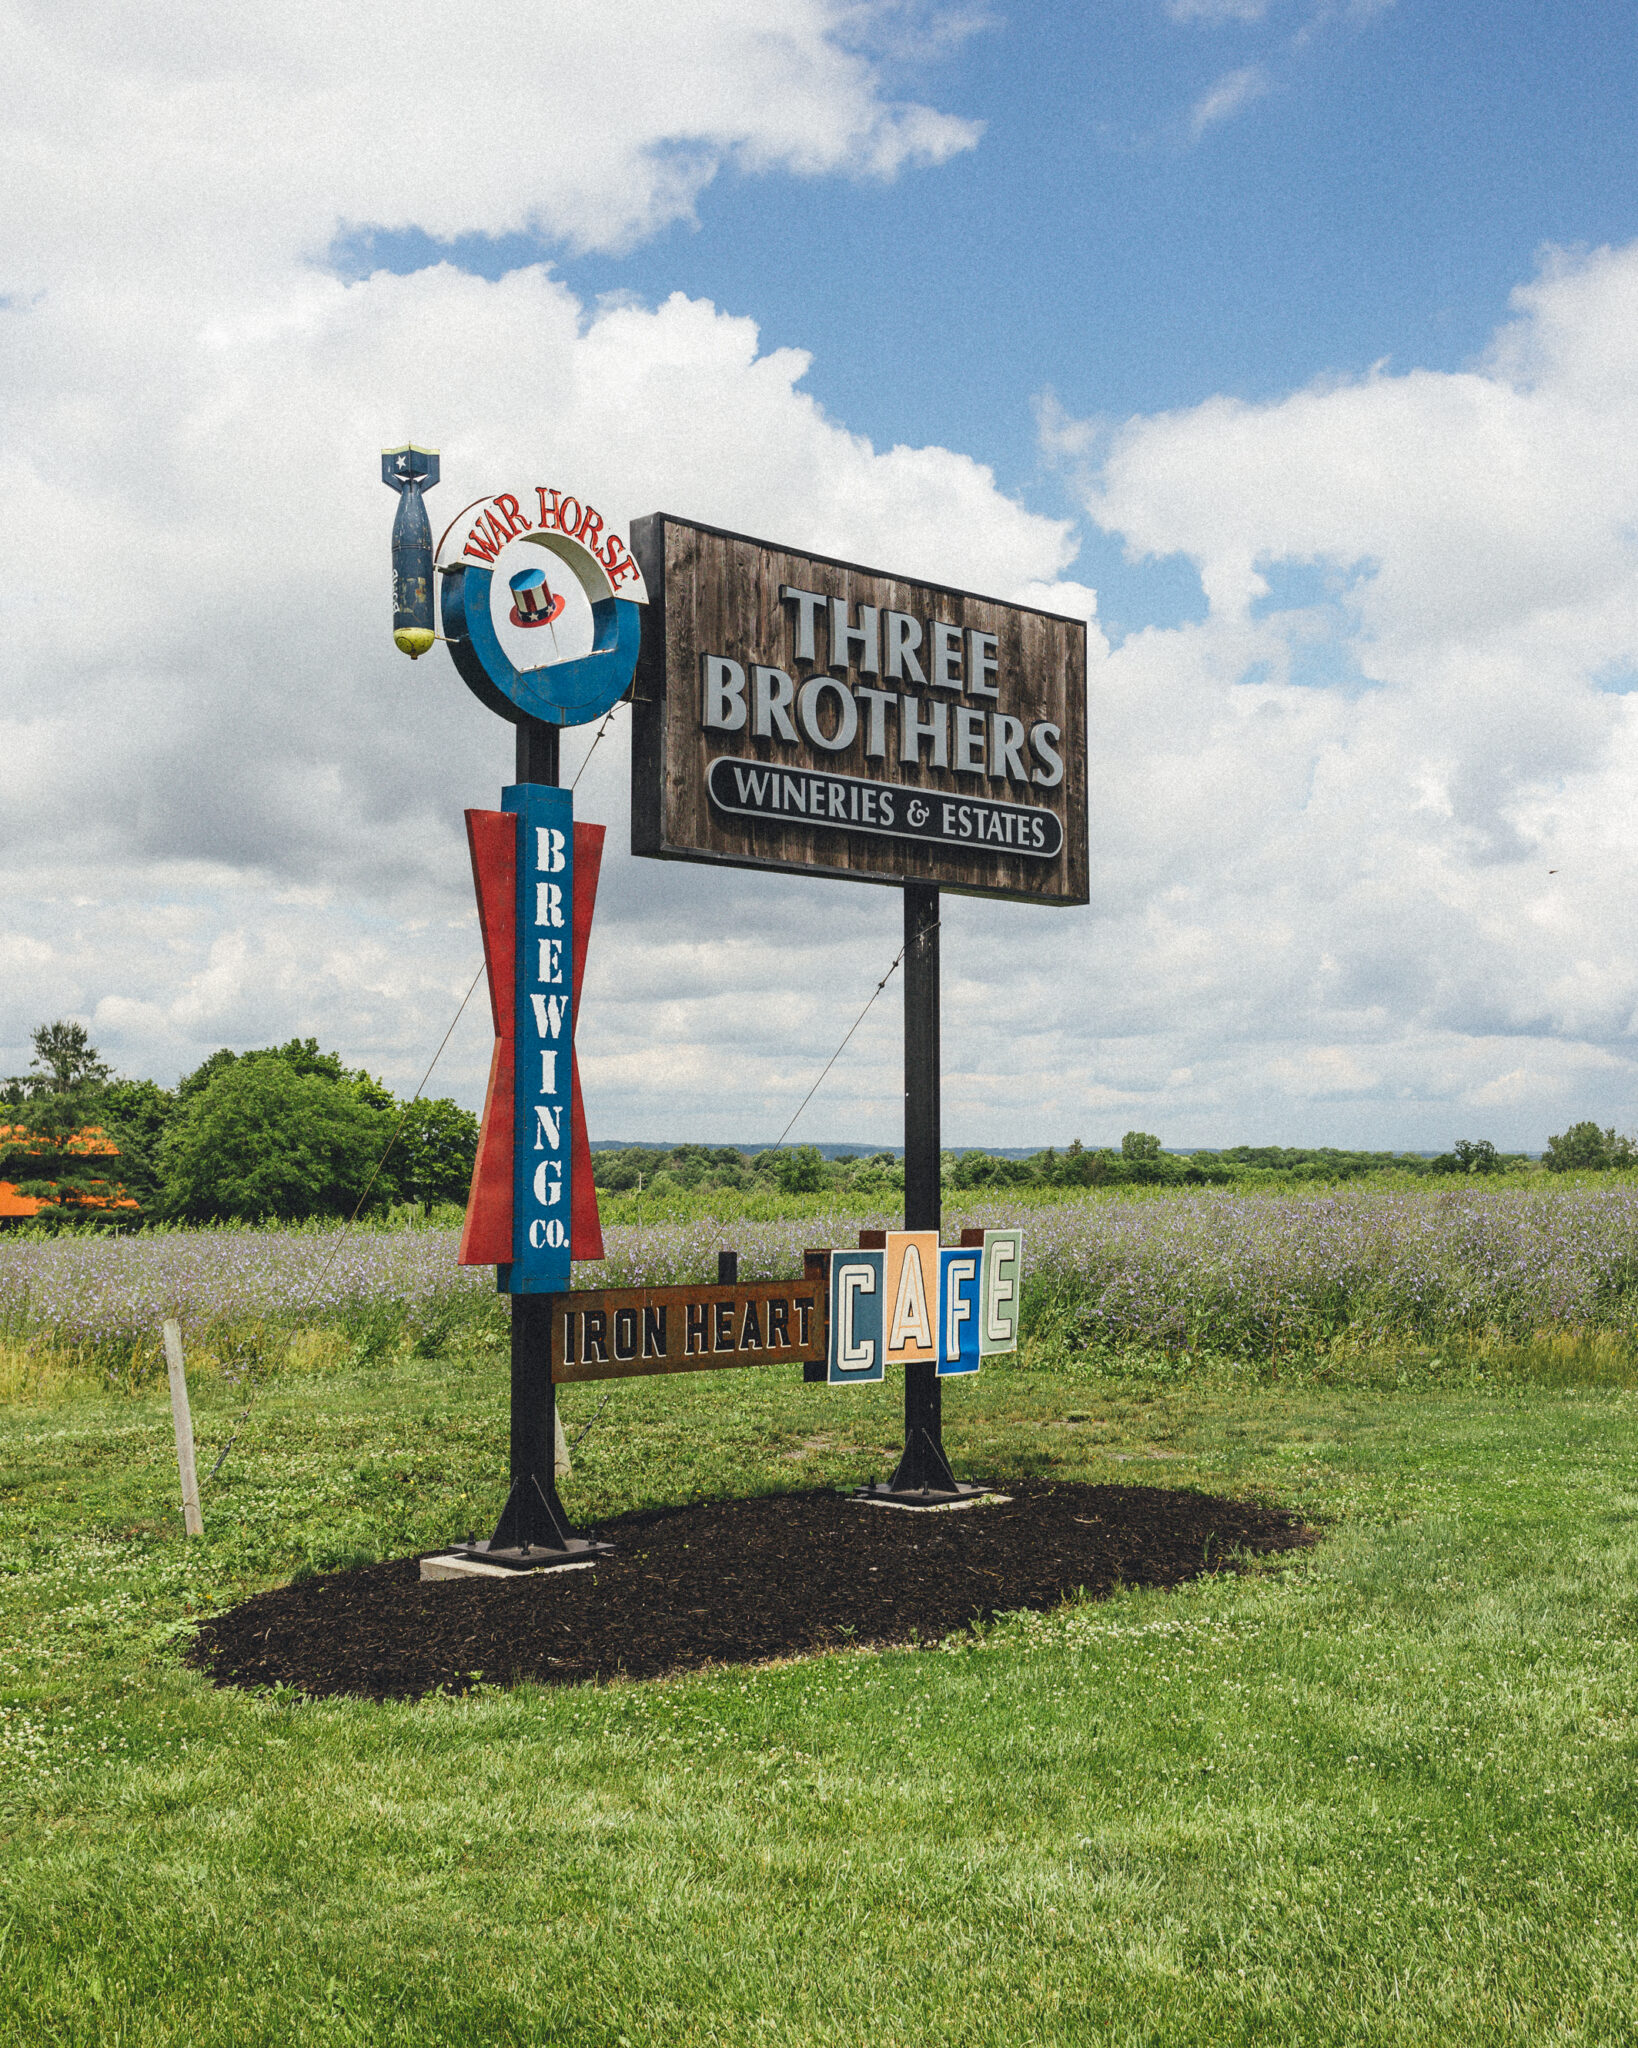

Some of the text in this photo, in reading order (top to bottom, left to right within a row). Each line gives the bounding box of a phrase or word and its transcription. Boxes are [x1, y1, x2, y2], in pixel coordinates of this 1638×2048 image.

[463, 487, 639, 591] WAR HORSE
[781, 584, 999, 699] THREE
[702, 653, 1064, 788] BROTHERS
[733, 766, 1046, 848] WINERIES & ESTATES
[529, 827, 569, 1206] BREWING
[529, 1219, 570, 1249] CO.
[563, 1298, 815, 1366] IRON HEART
[837, 1240, 1016, 1372] CAFE
